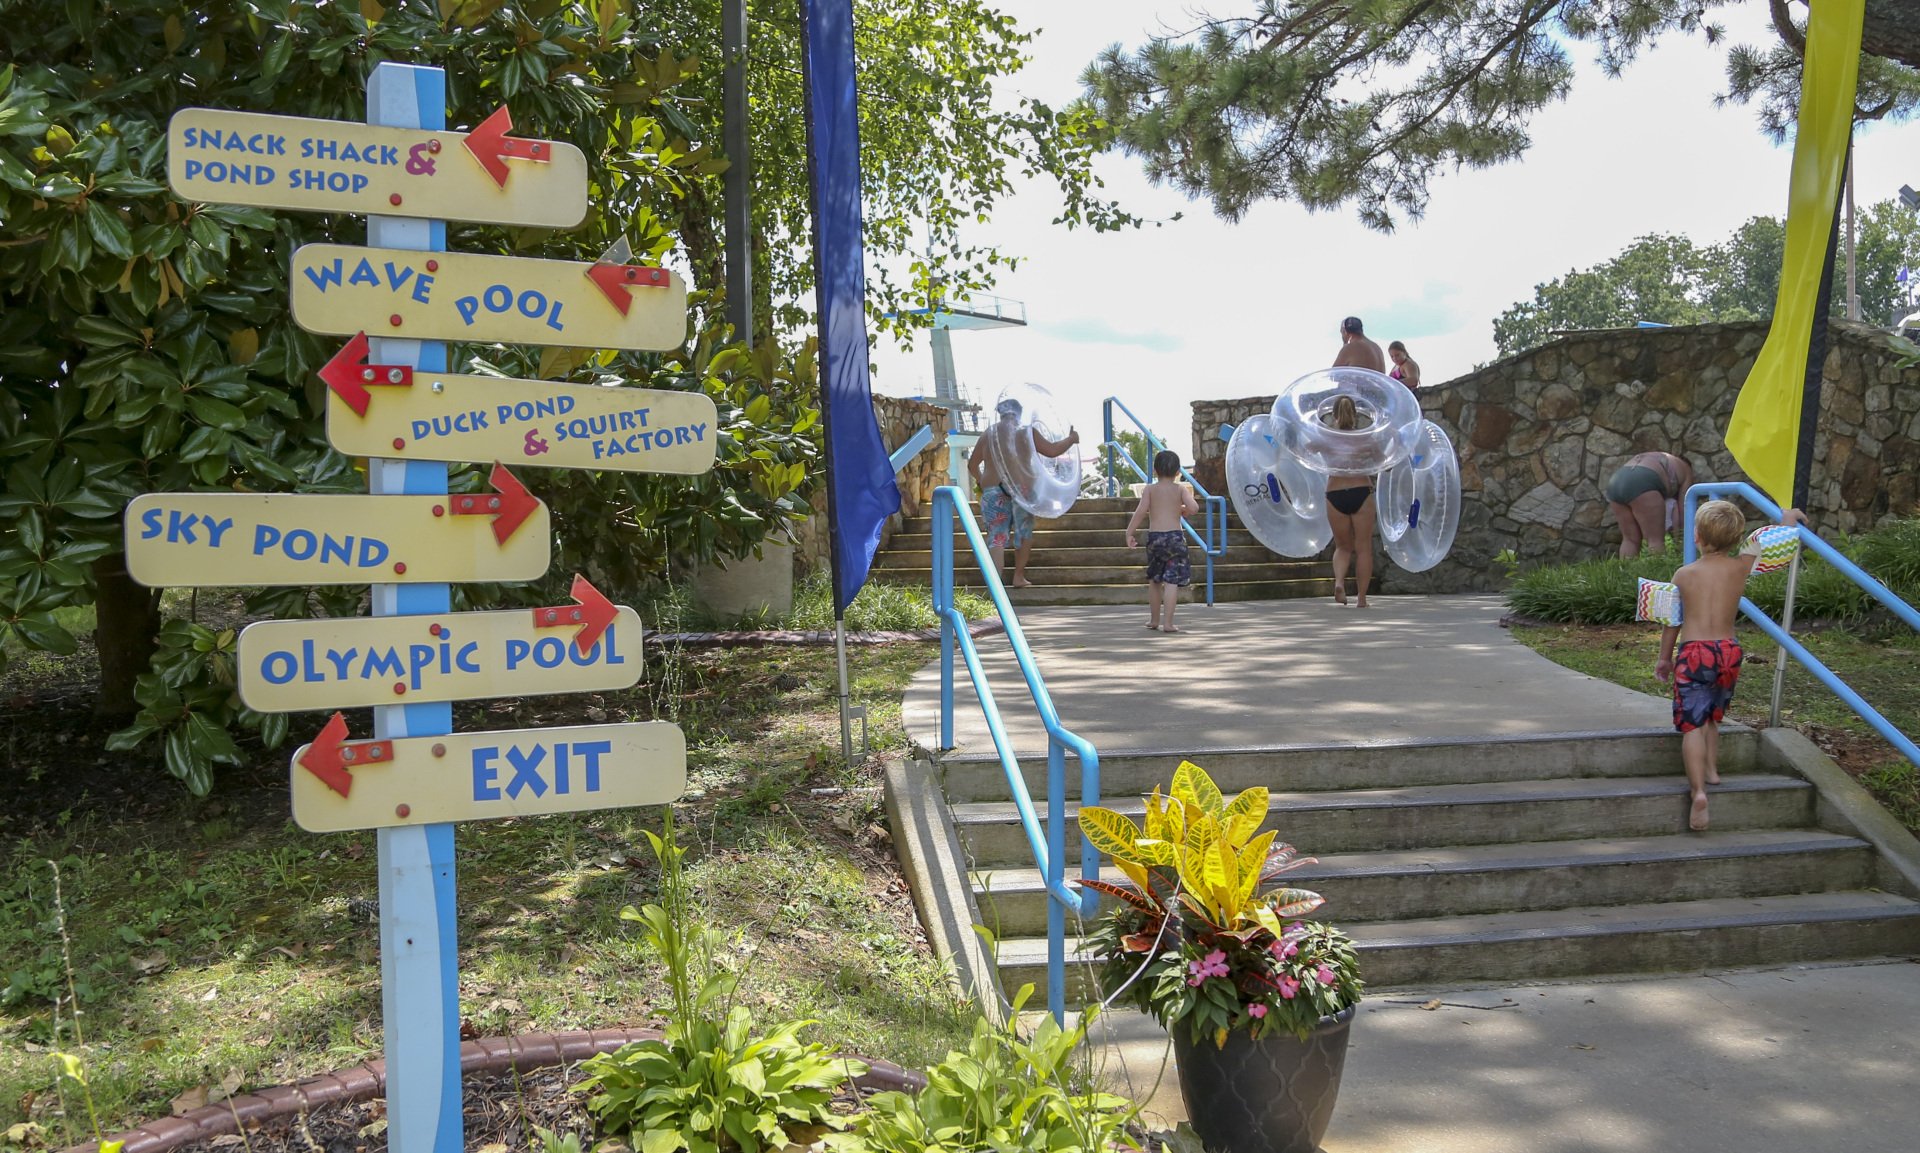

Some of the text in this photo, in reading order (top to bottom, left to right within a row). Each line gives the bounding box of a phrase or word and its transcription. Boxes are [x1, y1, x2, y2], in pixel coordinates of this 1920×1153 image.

[184, 127, 437, 177] SNACK SHACK &
[186, 160, 369, 193] POND SHOP
[304, 258, 565, 332] WAVE POOL
[412, 396, 575, 440] DUCK POND
[523, 408, 650, 456] & SQUIRT
[593, 423, 707, 459] FACTORY
[141, 508, 389, 569] SKY POND
[505, 622, 625, 670] POOL
[471, 740, 612, 801] EXIT
